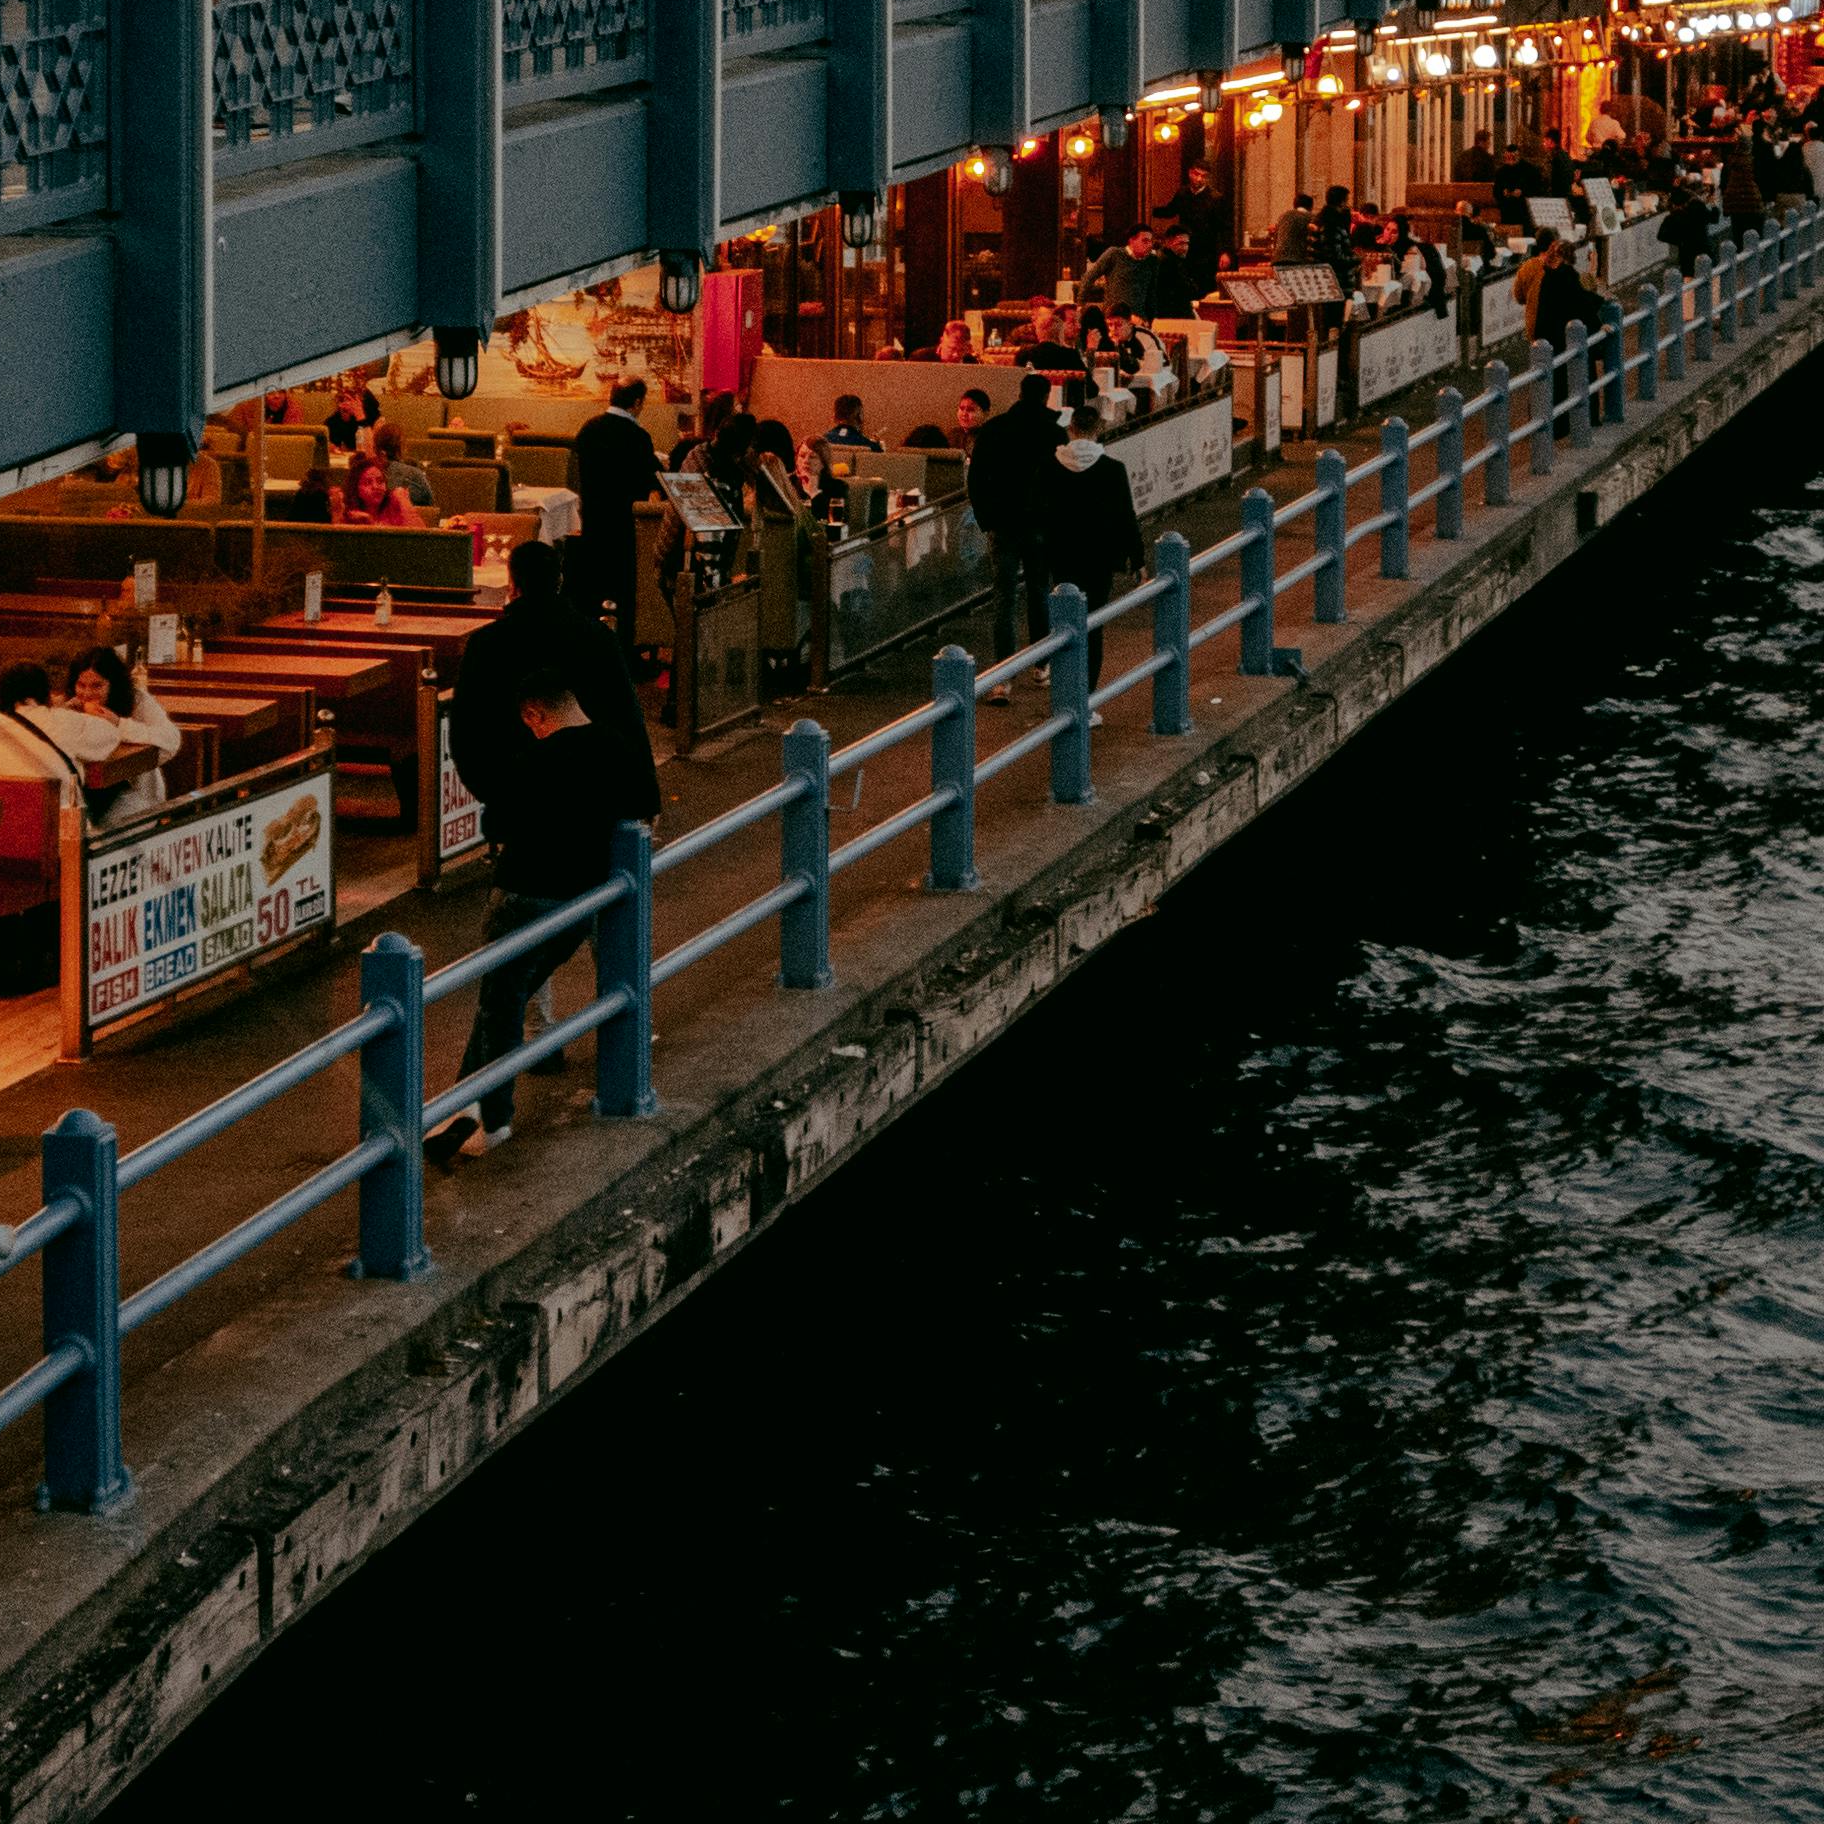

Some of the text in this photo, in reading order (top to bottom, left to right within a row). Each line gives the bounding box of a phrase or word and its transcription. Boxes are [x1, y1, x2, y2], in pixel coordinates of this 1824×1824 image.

[442, 768, 475, 816] BAL
[443, 814, 475, 850] FISH
[90, 852, 144, 910] LEZZET
[257, 888, 289, 945] 50
[295, 876, 320, 895] TL
[90, 861, 254, 974] BALIK EKMEK SALATA
[92, 919, 254, 1014] FISH BREAD SALAD
